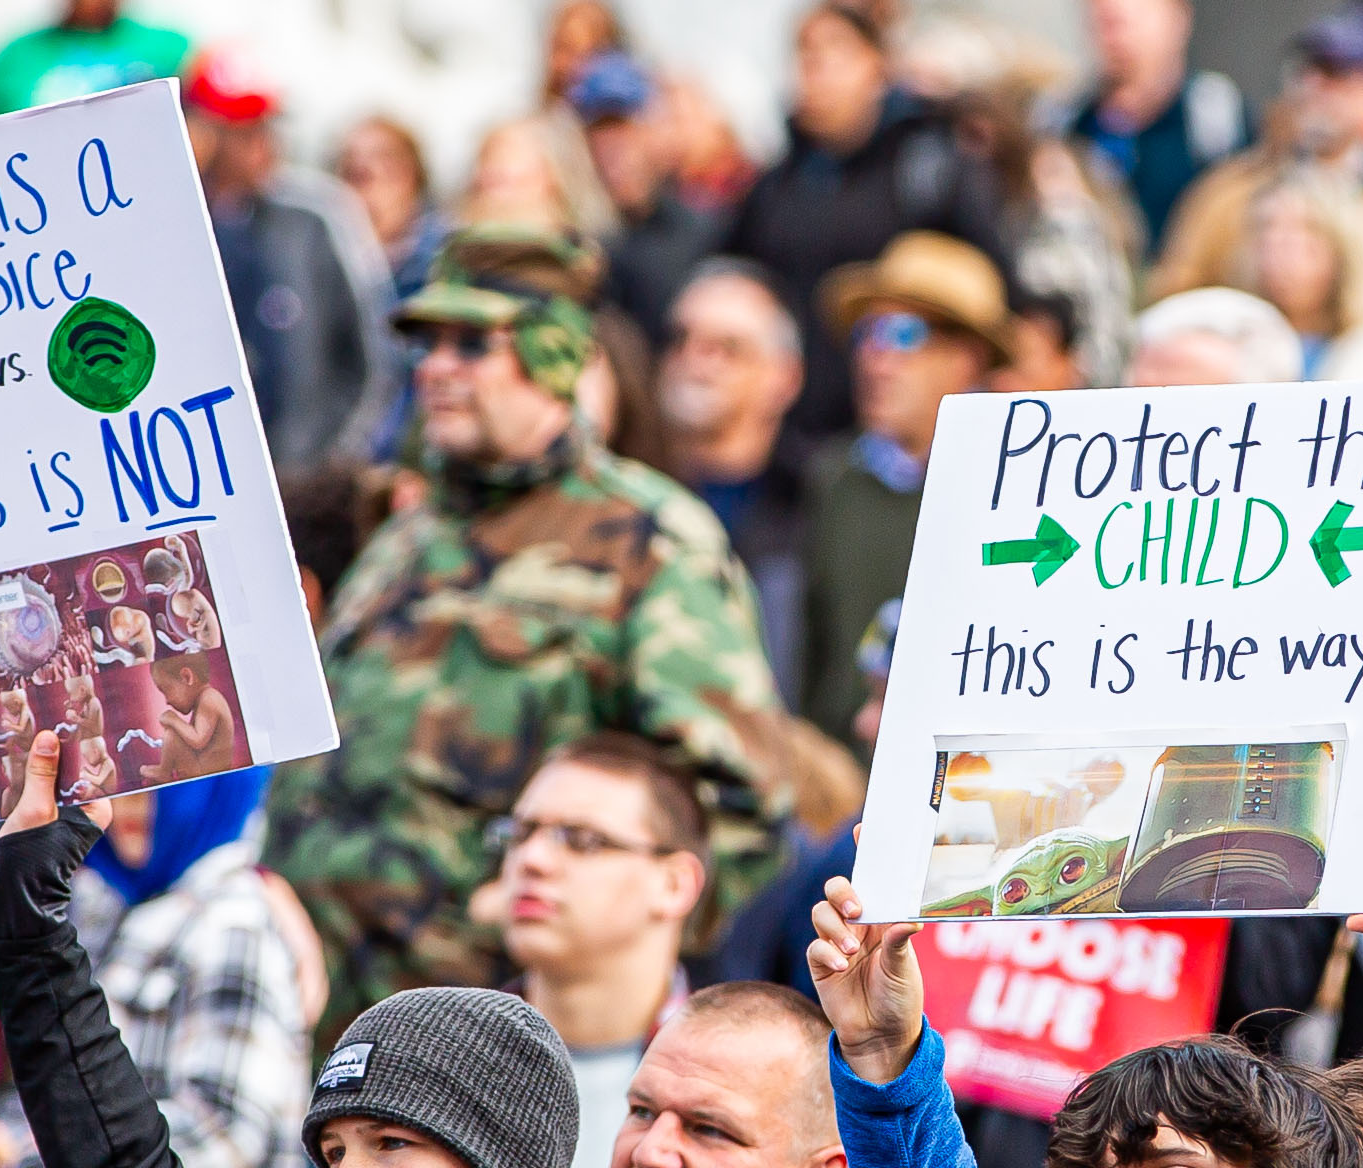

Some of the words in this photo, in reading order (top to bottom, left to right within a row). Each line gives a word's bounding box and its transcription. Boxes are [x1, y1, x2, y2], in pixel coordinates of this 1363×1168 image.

[77, 137, 134, 217] a
[26, 450, 84, 519] is
[100, 386, 235, 523] NOT
[991, 398, 1262, 511] Protect
[1094, 496, 1289, 590] CHILD
[951, 622, 1055, 697] this
[1090, 624, 1138, 695] is
[1166, 618, 1258, 683] the
